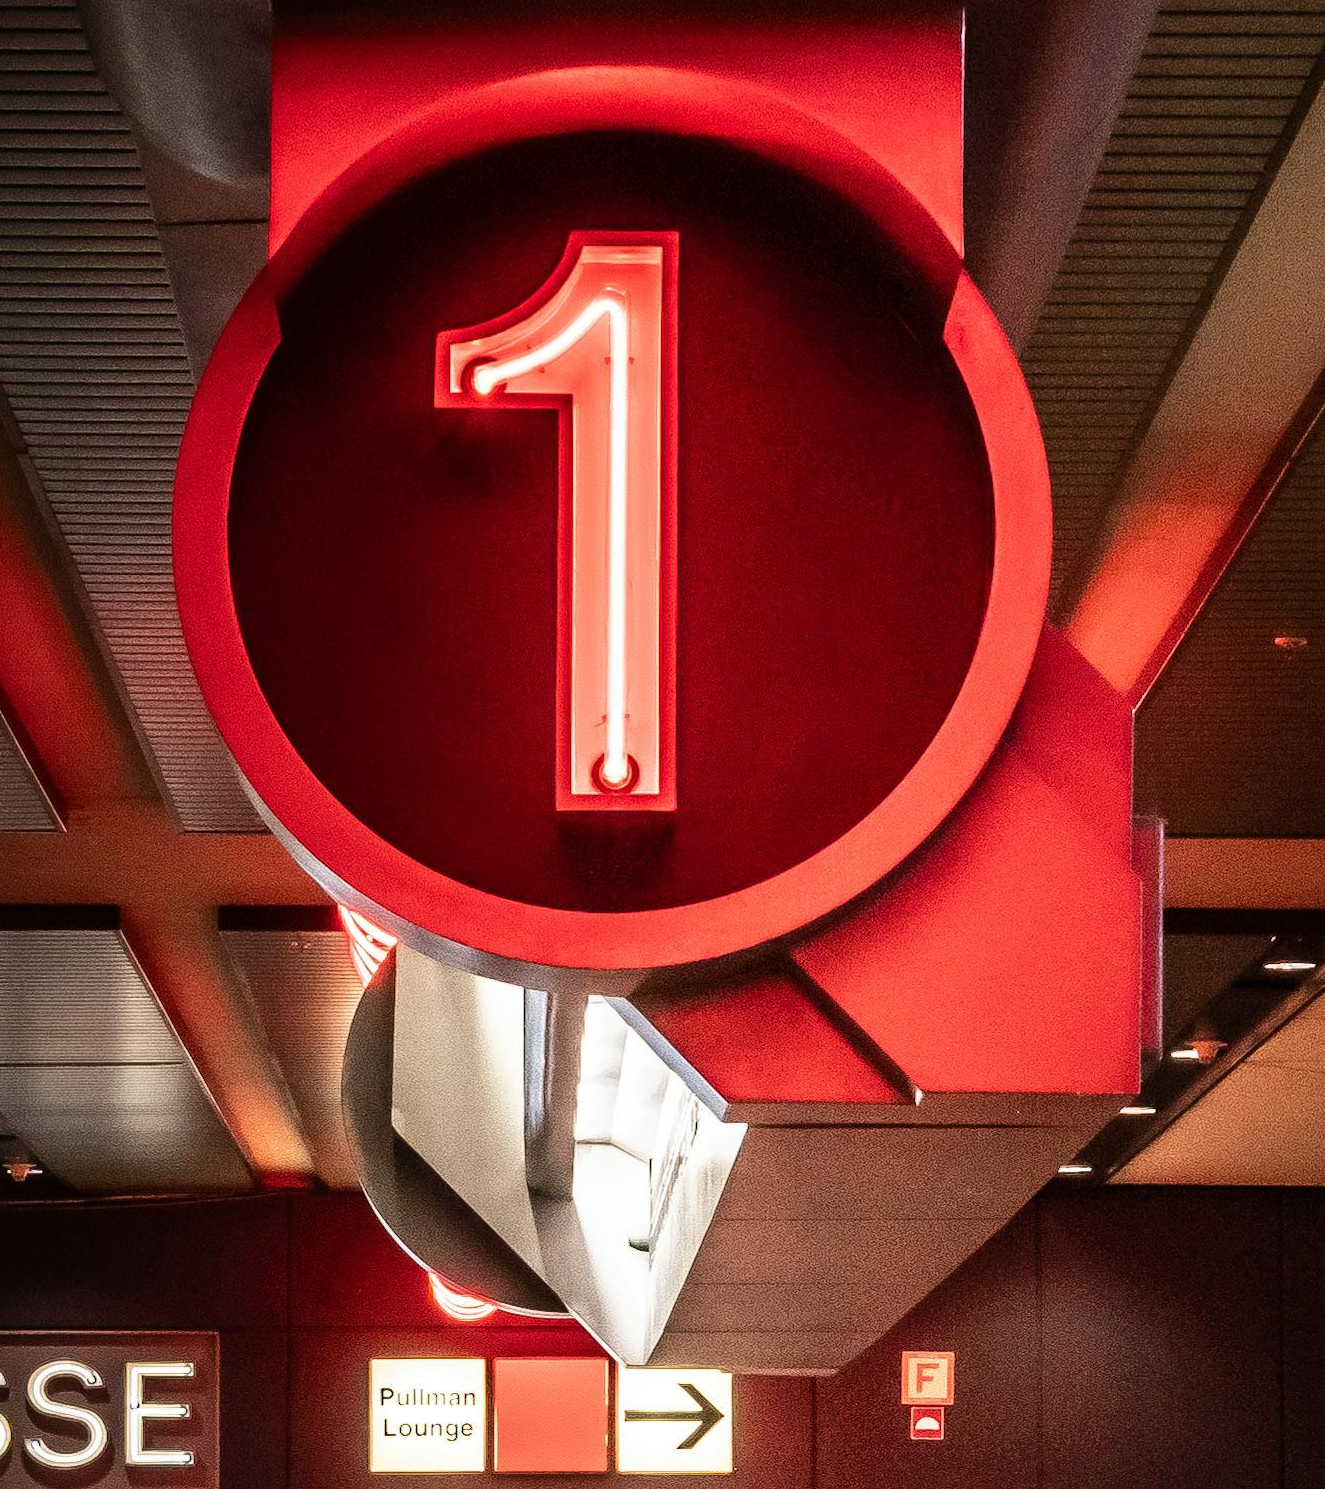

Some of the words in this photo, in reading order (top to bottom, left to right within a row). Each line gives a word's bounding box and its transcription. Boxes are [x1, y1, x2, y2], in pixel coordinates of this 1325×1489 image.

[434, 230, 680, 812] 1
[915, 1363, 940, 1394] F
[380, 1387, 476, 1406] Pullman
[384, 1418, 473, 1442] Lounge
